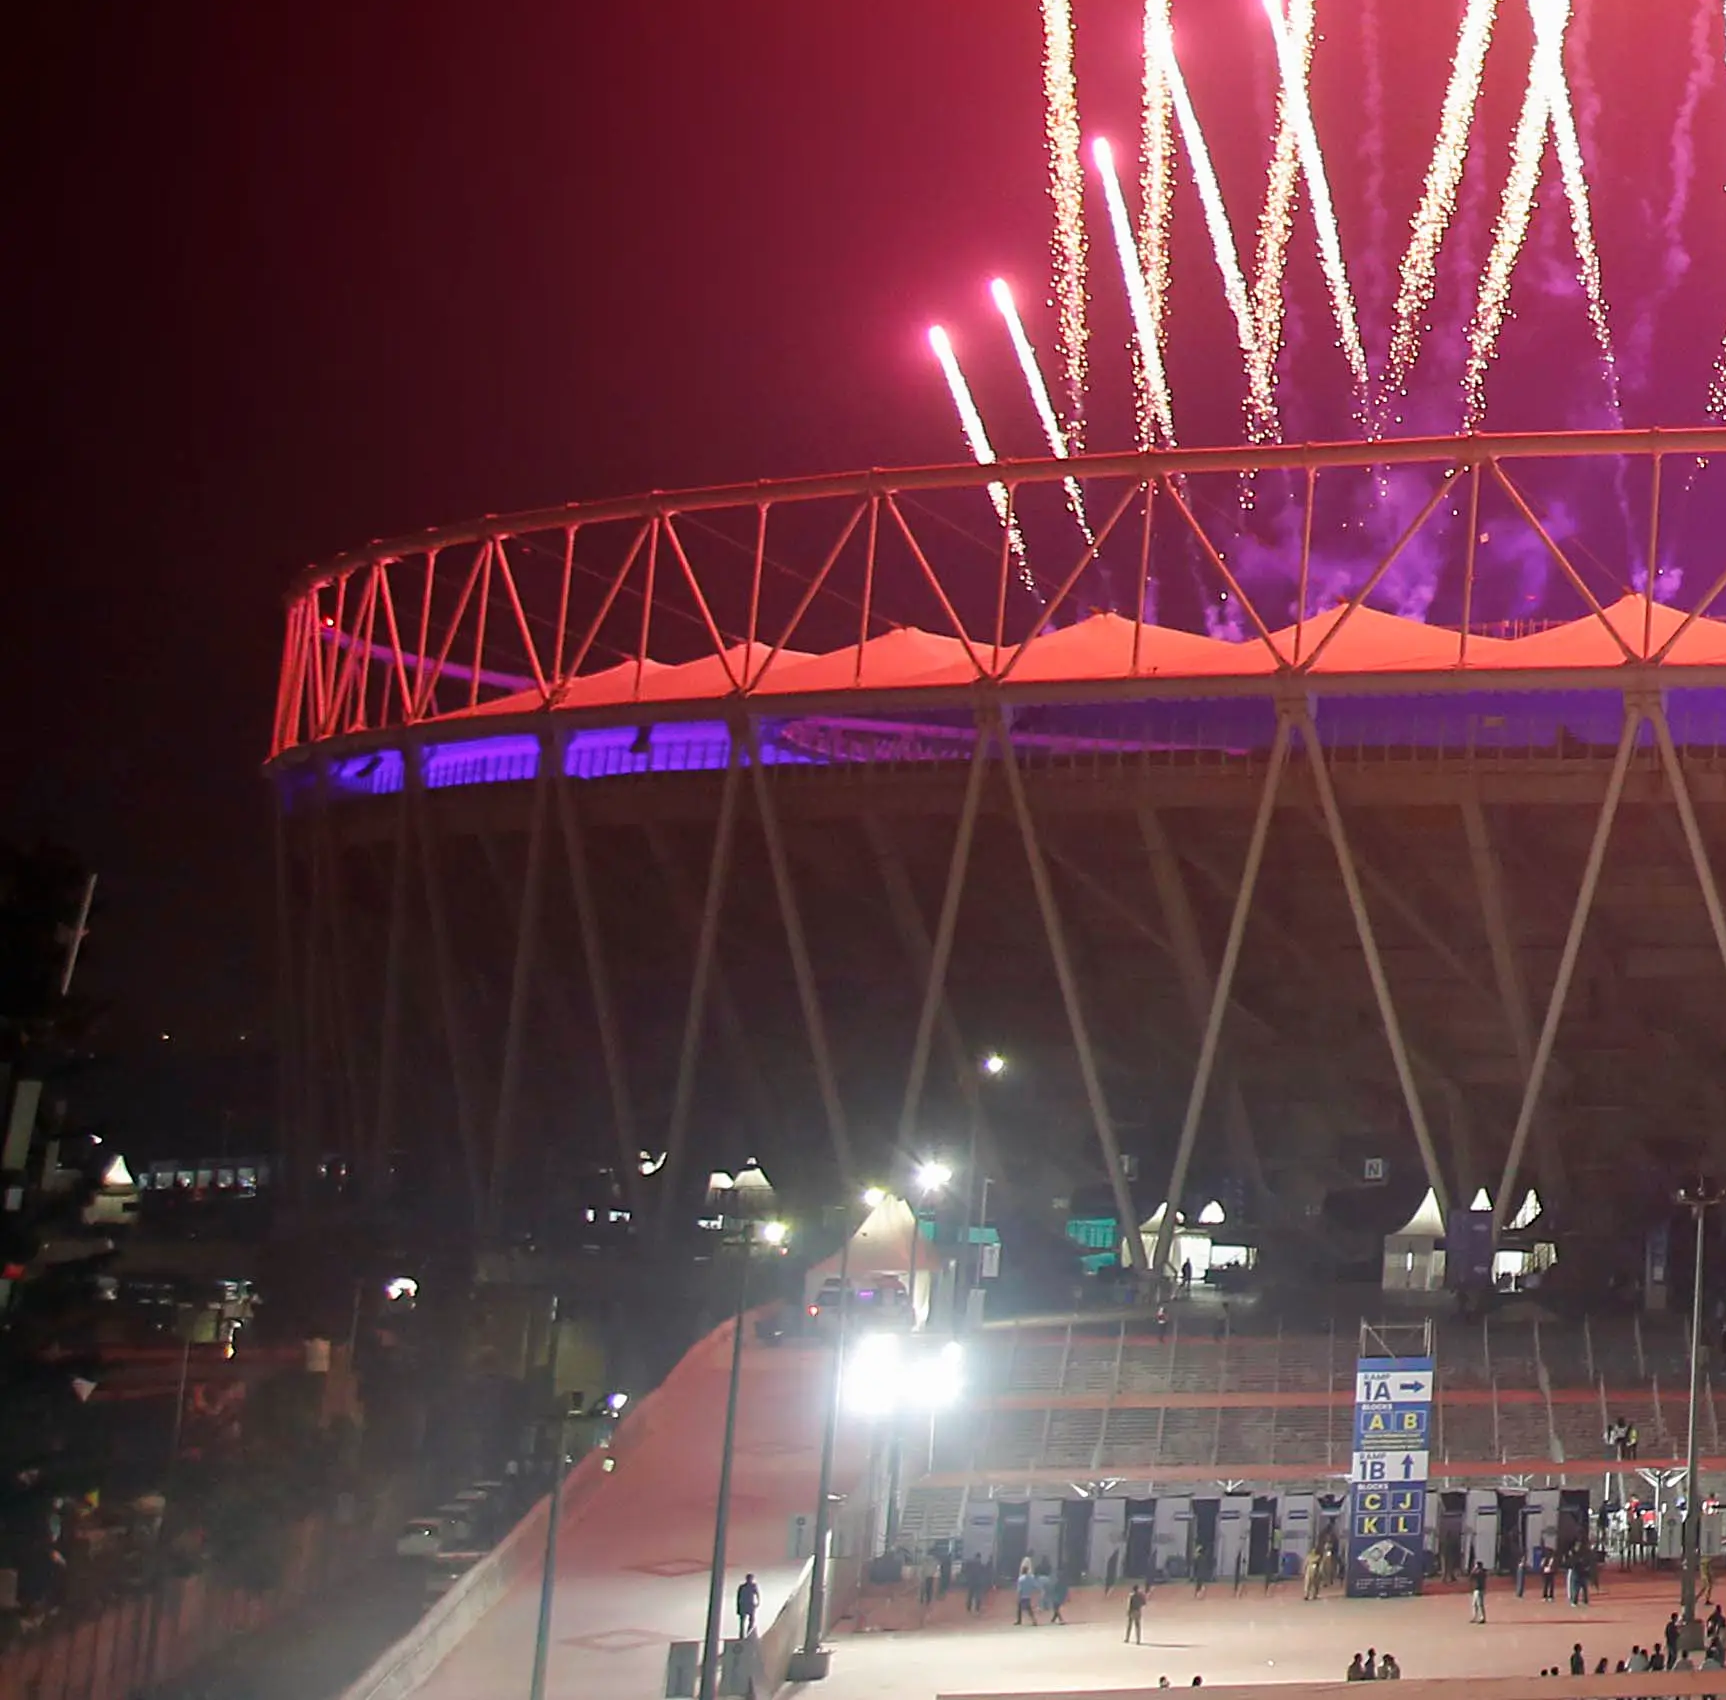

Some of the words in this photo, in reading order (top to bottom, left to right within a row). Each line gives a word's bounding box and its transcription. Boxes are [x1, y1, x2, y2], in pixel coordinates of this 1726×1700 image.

[1364, 1381, 1391, 1400] 1A
[1369, 1414, 1384, 1430] A
[1404, 1413, 1417, 1429] B
[1360, 1461, 1386, 1480] 1B
[1364, 1494, 1381, 1509] C
[1399, 1492, 1411, 1509] J
[1363, 1517, 1377, 1534] K
[1397, 1516, 1408, 1532] L
